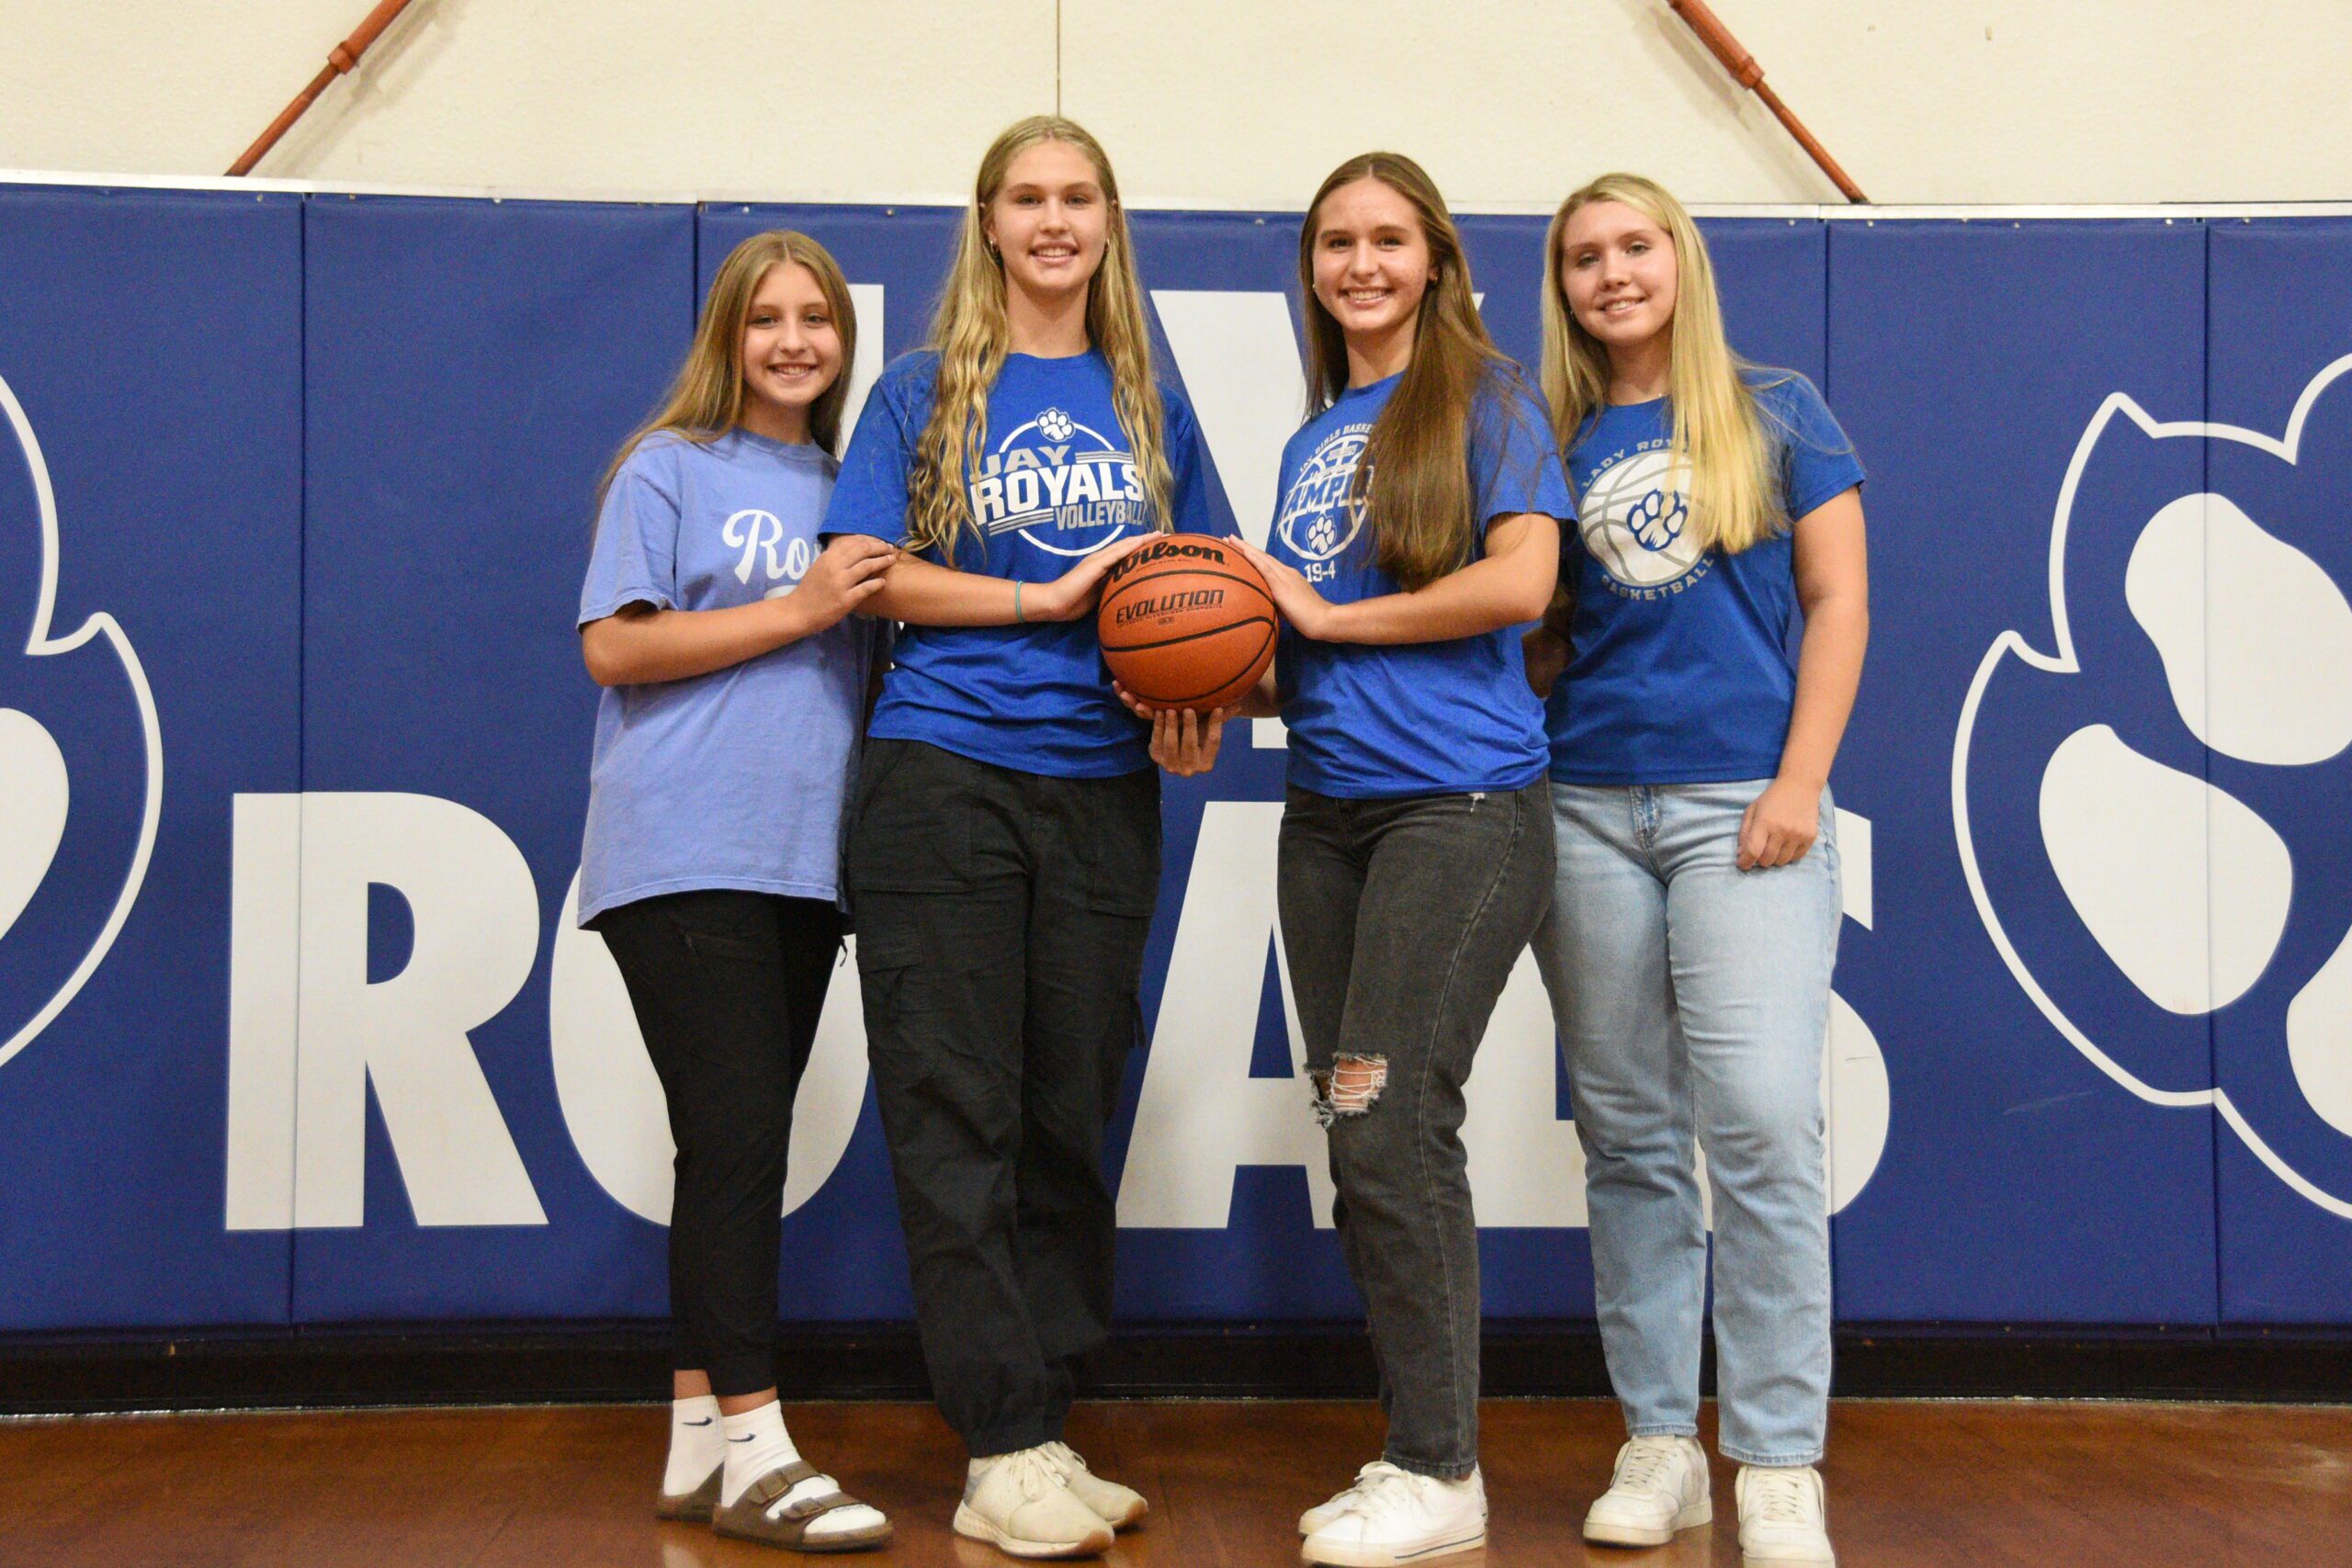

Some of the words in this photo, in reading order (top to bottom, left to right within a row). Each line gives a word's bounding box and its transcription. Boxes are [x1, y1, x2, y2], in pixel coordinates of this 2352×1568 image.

[1342, 423, 1374, 435] BASKE
[969, 446, 1070, 482] JAY
[1582, 448, 1625, 488] LADY
[970, 462, 1145, 525] ROYALS
[1056, 501, 1145, 531] VOLLEYBALL
[1109, 541, 1225, 582] Wilson
[1305, 559, 1336, 582] 19-4
[1601, 558, 1714, 601] BASKETBALL
[1116, 590, 1224, 624] EVOLUTION
